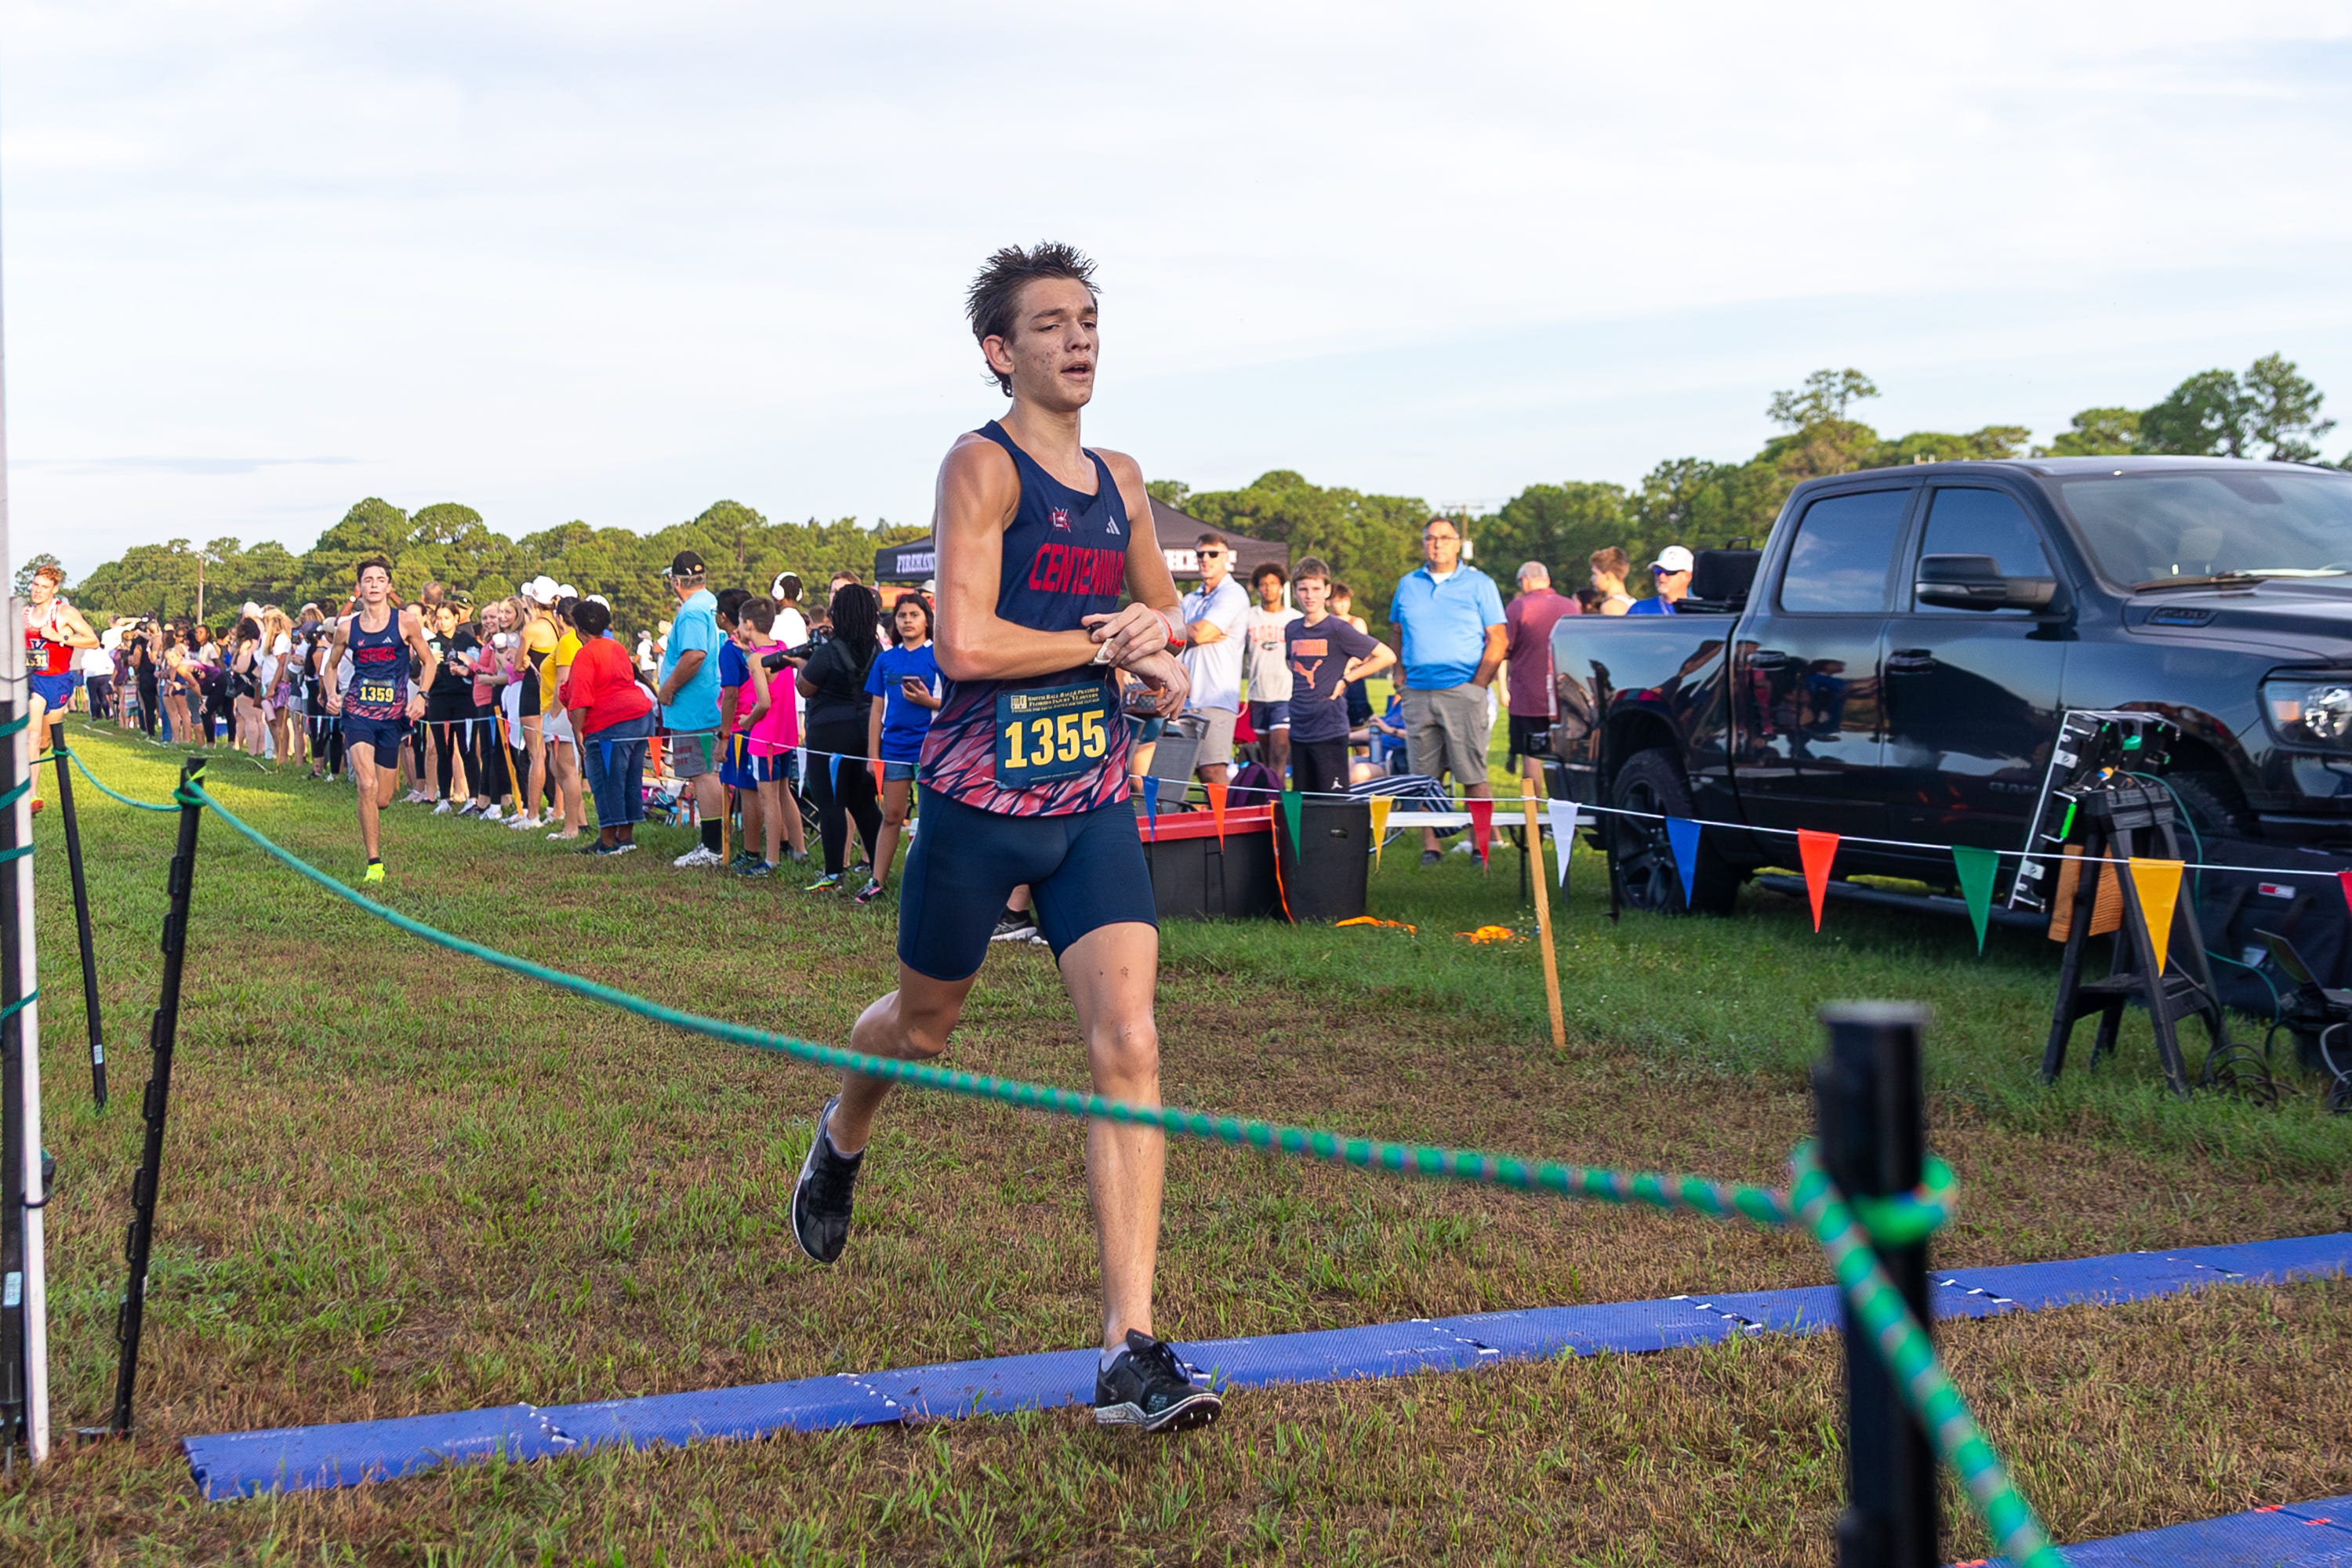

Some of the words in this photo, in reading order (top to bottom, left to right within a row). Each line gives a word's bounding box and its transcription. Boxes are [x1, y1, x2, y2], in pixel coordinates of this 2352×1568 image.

[1029, 543, 1124, 597] CENTENNIA
[360, 686, 394, 702] 1359
[1005, 710, 1106, 768] 1355
